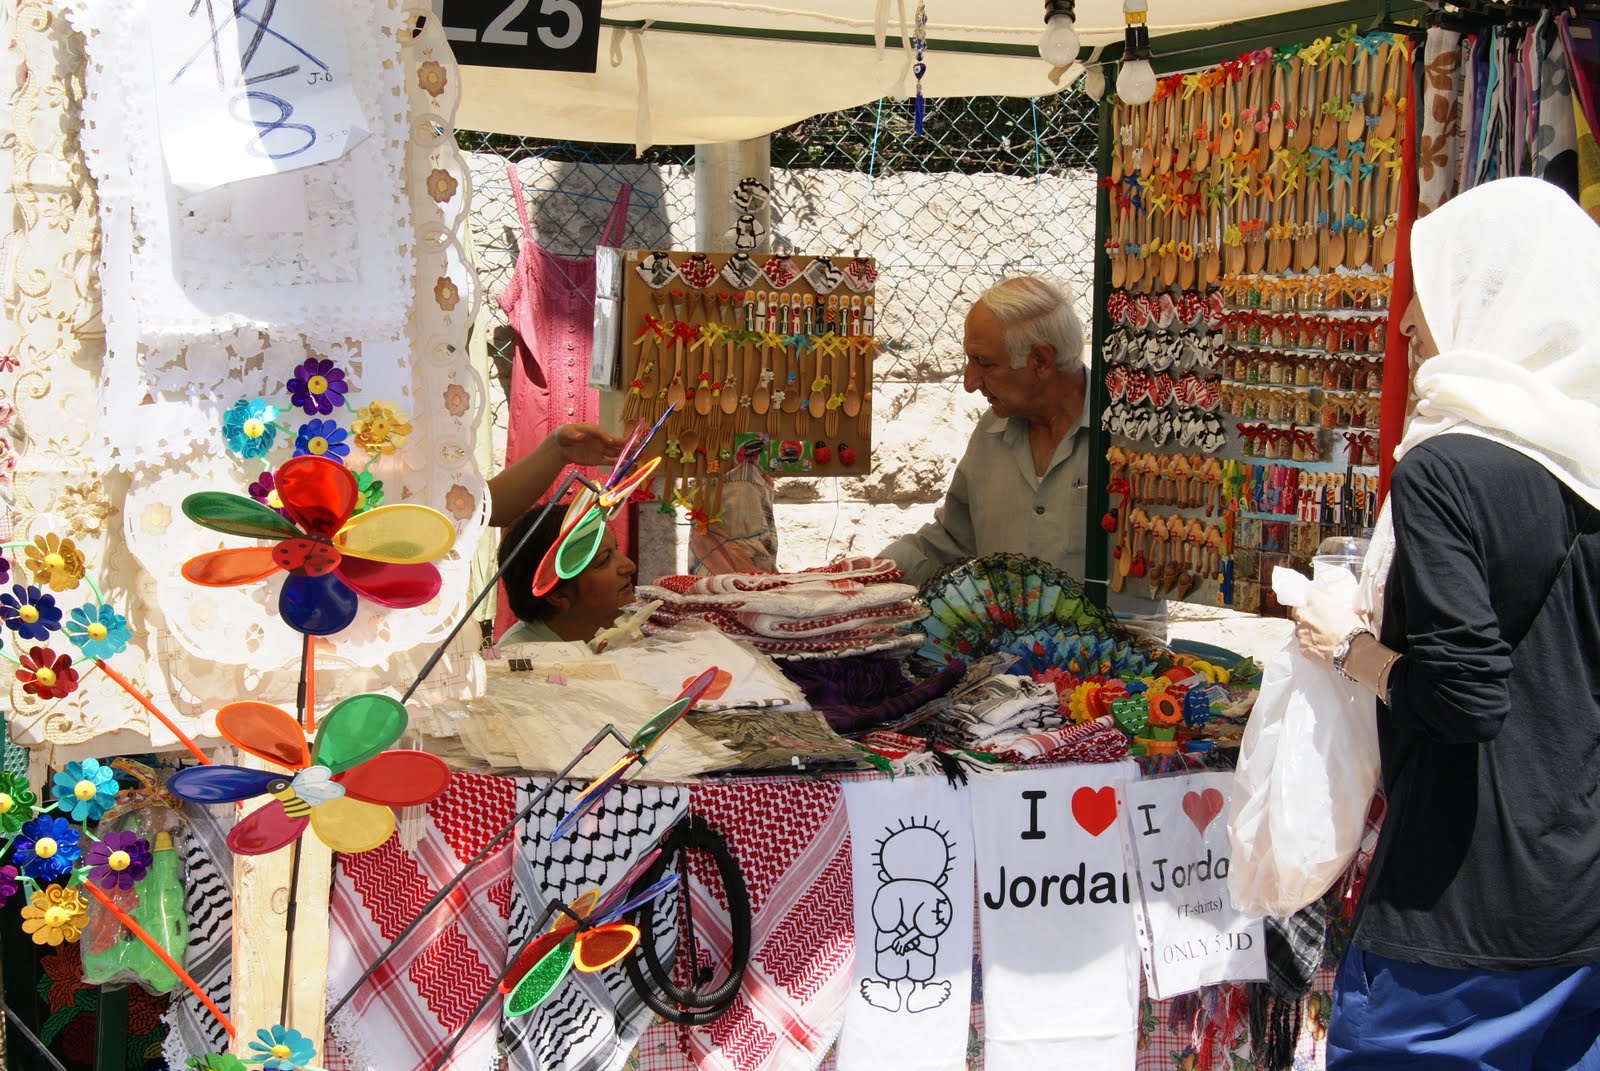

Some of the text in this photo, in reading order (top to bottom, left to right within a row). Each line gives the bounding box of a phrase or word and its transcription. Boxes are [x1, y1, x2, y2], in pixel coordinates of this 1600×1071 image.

[228, 91, 316, 159] 8
[1021, 790, 1046, 840] I
[1138, 804, 1160, 836] I
[1163, 938, 1208, 965] ONLY
[1225, 932, 1253, 951] JD
